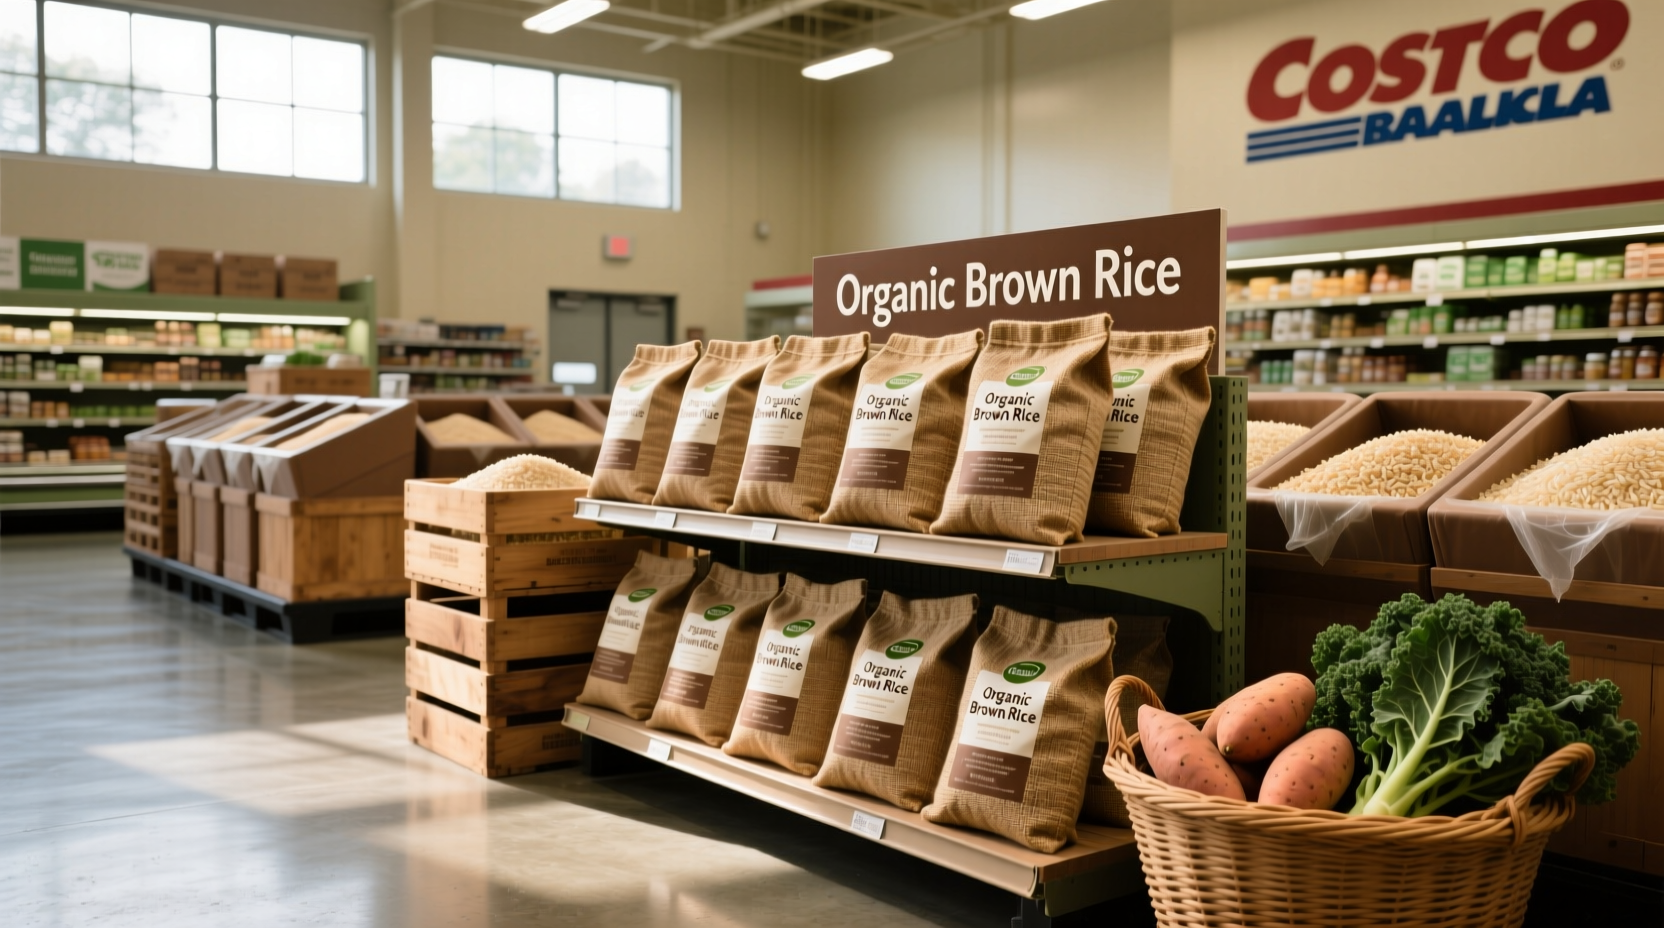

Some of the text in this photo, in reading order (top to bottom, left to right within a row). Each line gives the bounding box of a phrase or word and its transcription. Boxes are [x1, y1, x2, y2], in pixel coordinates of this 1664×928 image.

[1246, 0, 1630, 122] COSTCO
[836, 245, 1181, 328] Organic Brown Rice
[985, 392, 1035, 408] Organic
[864, 661, 907, 679] Organic
[983, 686, 1032, 706] Organic
[970, 701, 1005, 720] Brown
